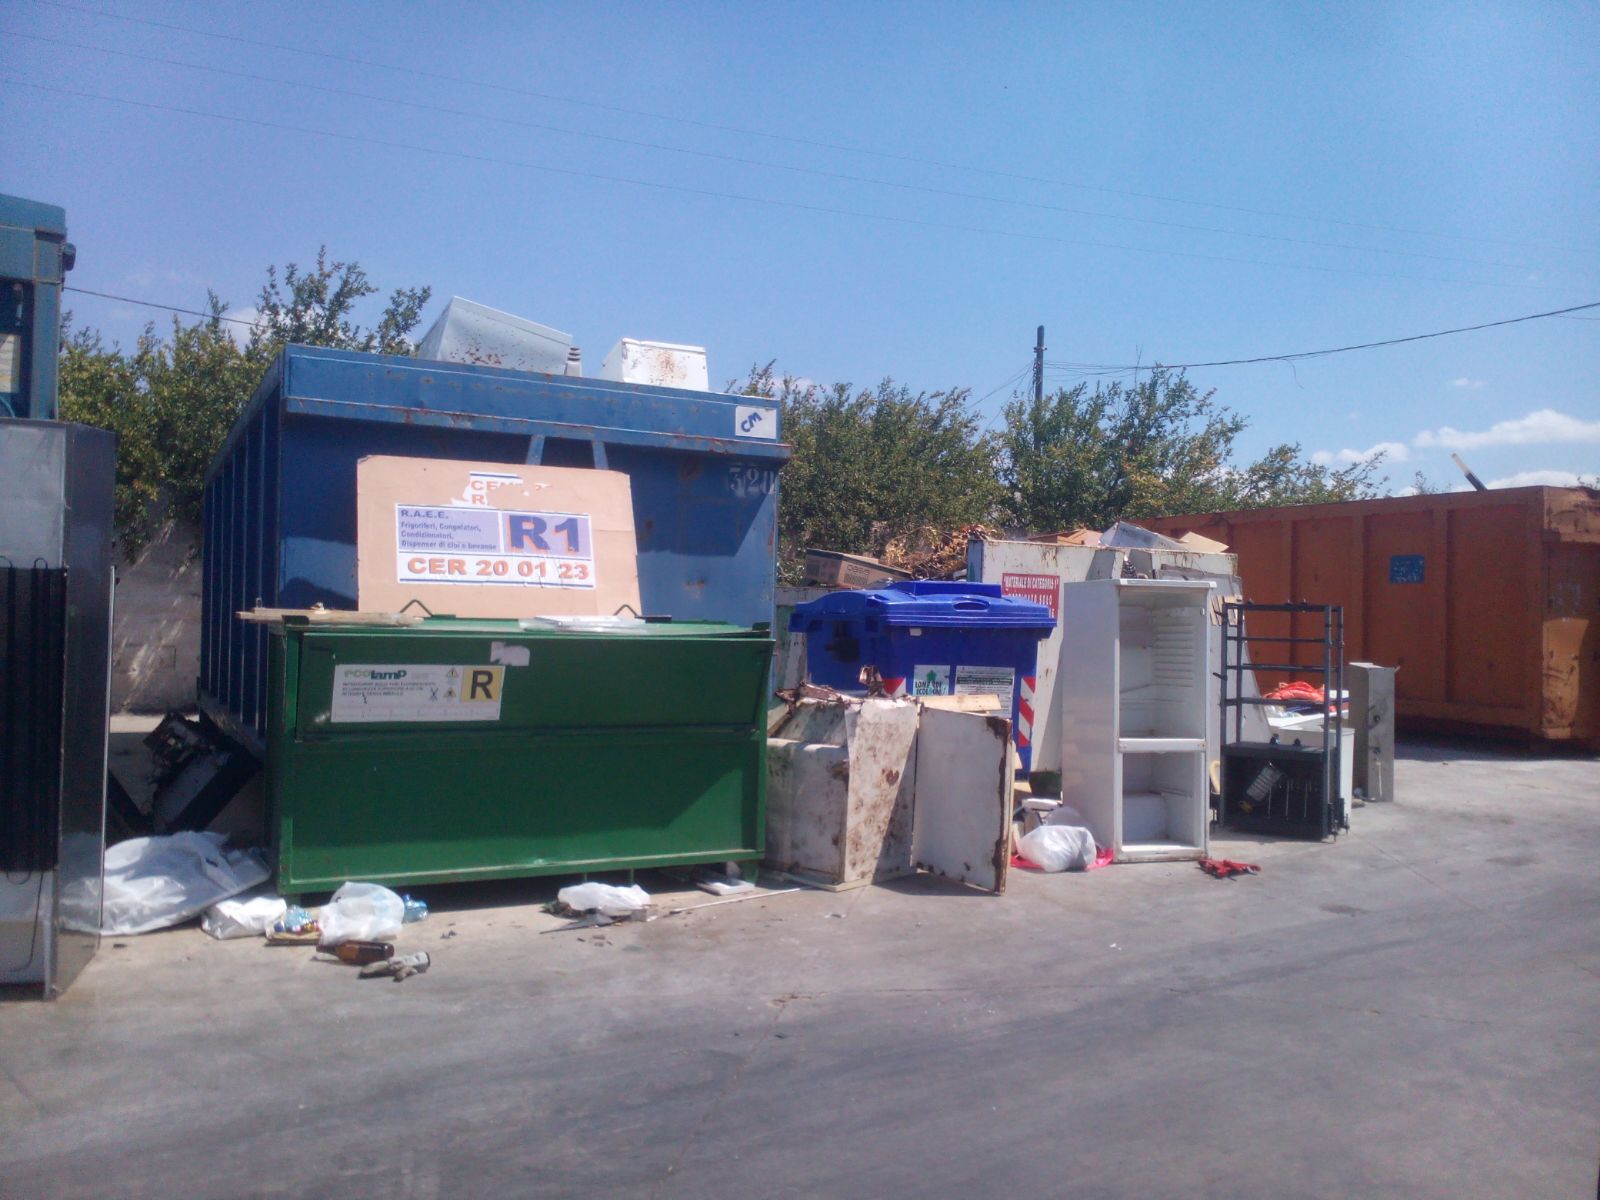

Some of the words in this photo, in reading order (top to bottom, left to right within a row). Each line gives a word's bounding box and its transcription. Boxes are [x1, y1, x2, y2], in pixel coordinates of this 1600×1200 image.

[400, 509, 449, 519] R.A.E.E.
[400, 522, 438, 532] Frigoriferi,
[439, 523, 482, 533] Congelatori,
[400, 530, 454, 540] Condizionatori,
[508, 514, 580, 553] R1
[401, 540, 437, 549] Dispenser
[438, 541, 446, 549] di
[407, 557, 467, 576] CER
[475, 560, 509, 577] 20
[517, 561, 547, 578] 01
[558, 563, 590, 580] 23
[470, 670, 493, 700] R
